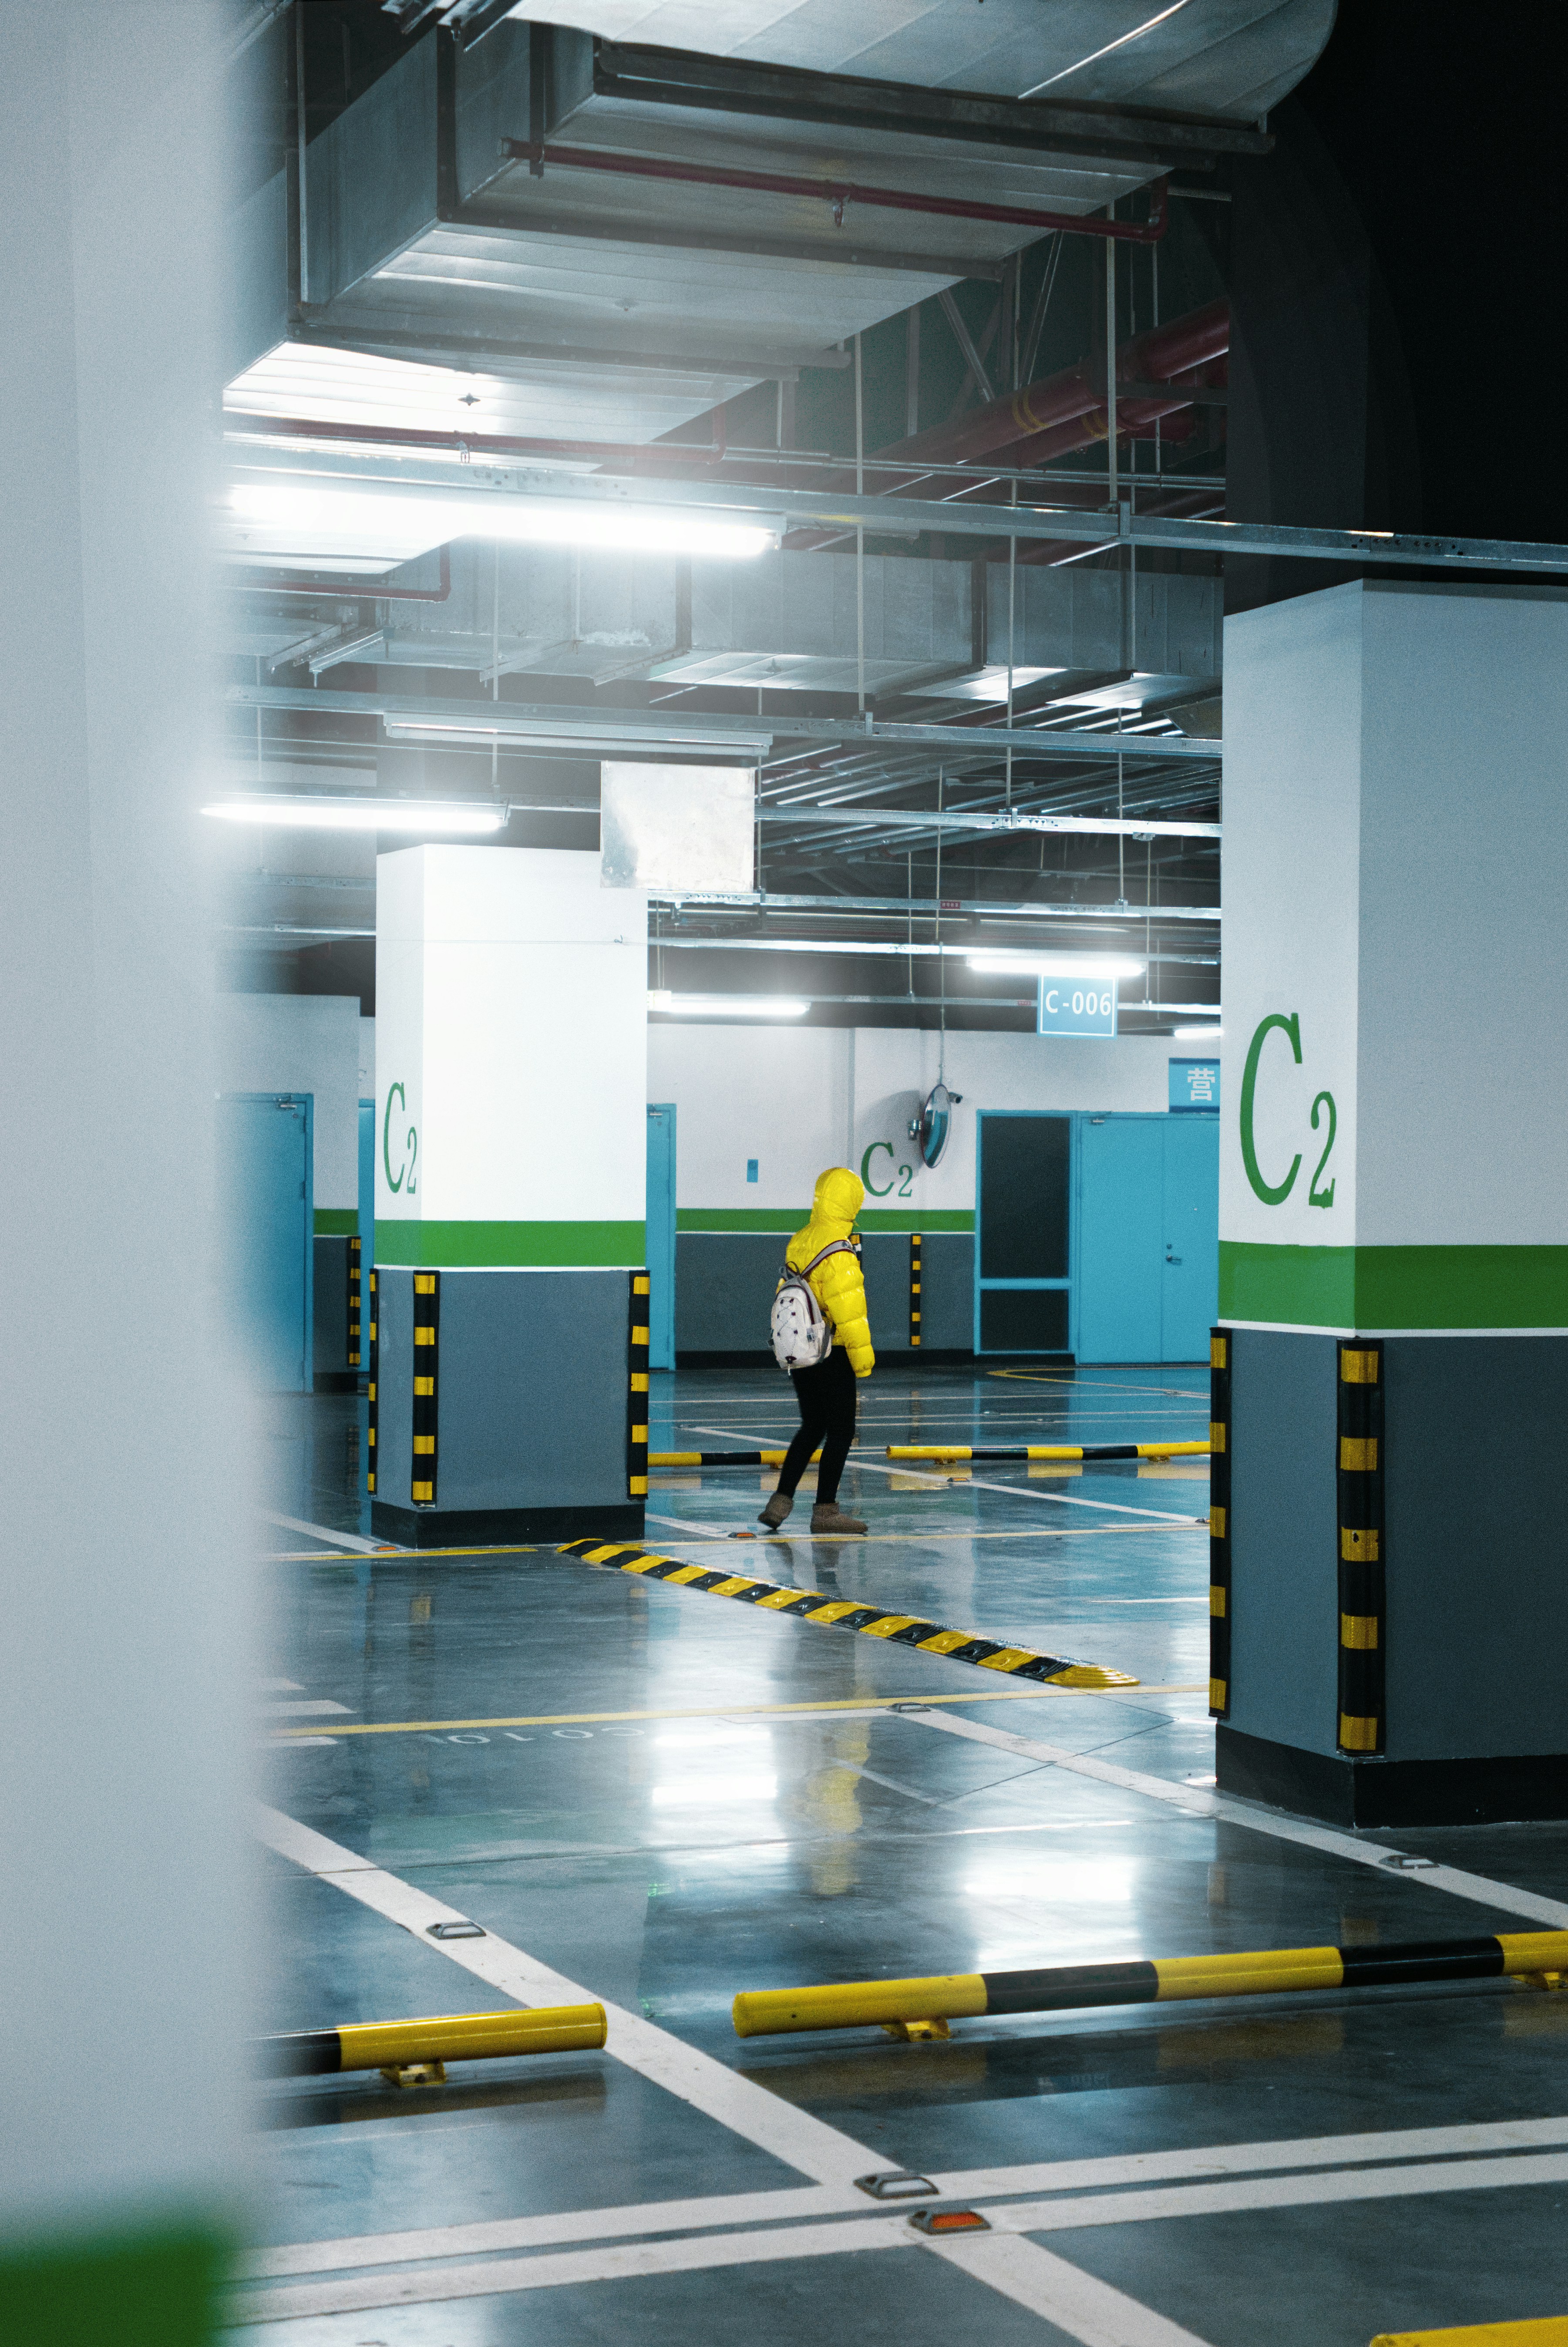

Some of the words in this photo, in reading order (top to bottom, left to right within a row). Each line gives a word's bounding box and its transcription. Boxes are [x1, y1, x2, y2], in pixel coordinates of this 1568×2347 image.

[1187, 1068, 1215, 1101] 营
[1240, 1013, 1336, 1209] C2
[384, 1082, 417, 1194] C2
[861, 1142, 913, 1197] C2
